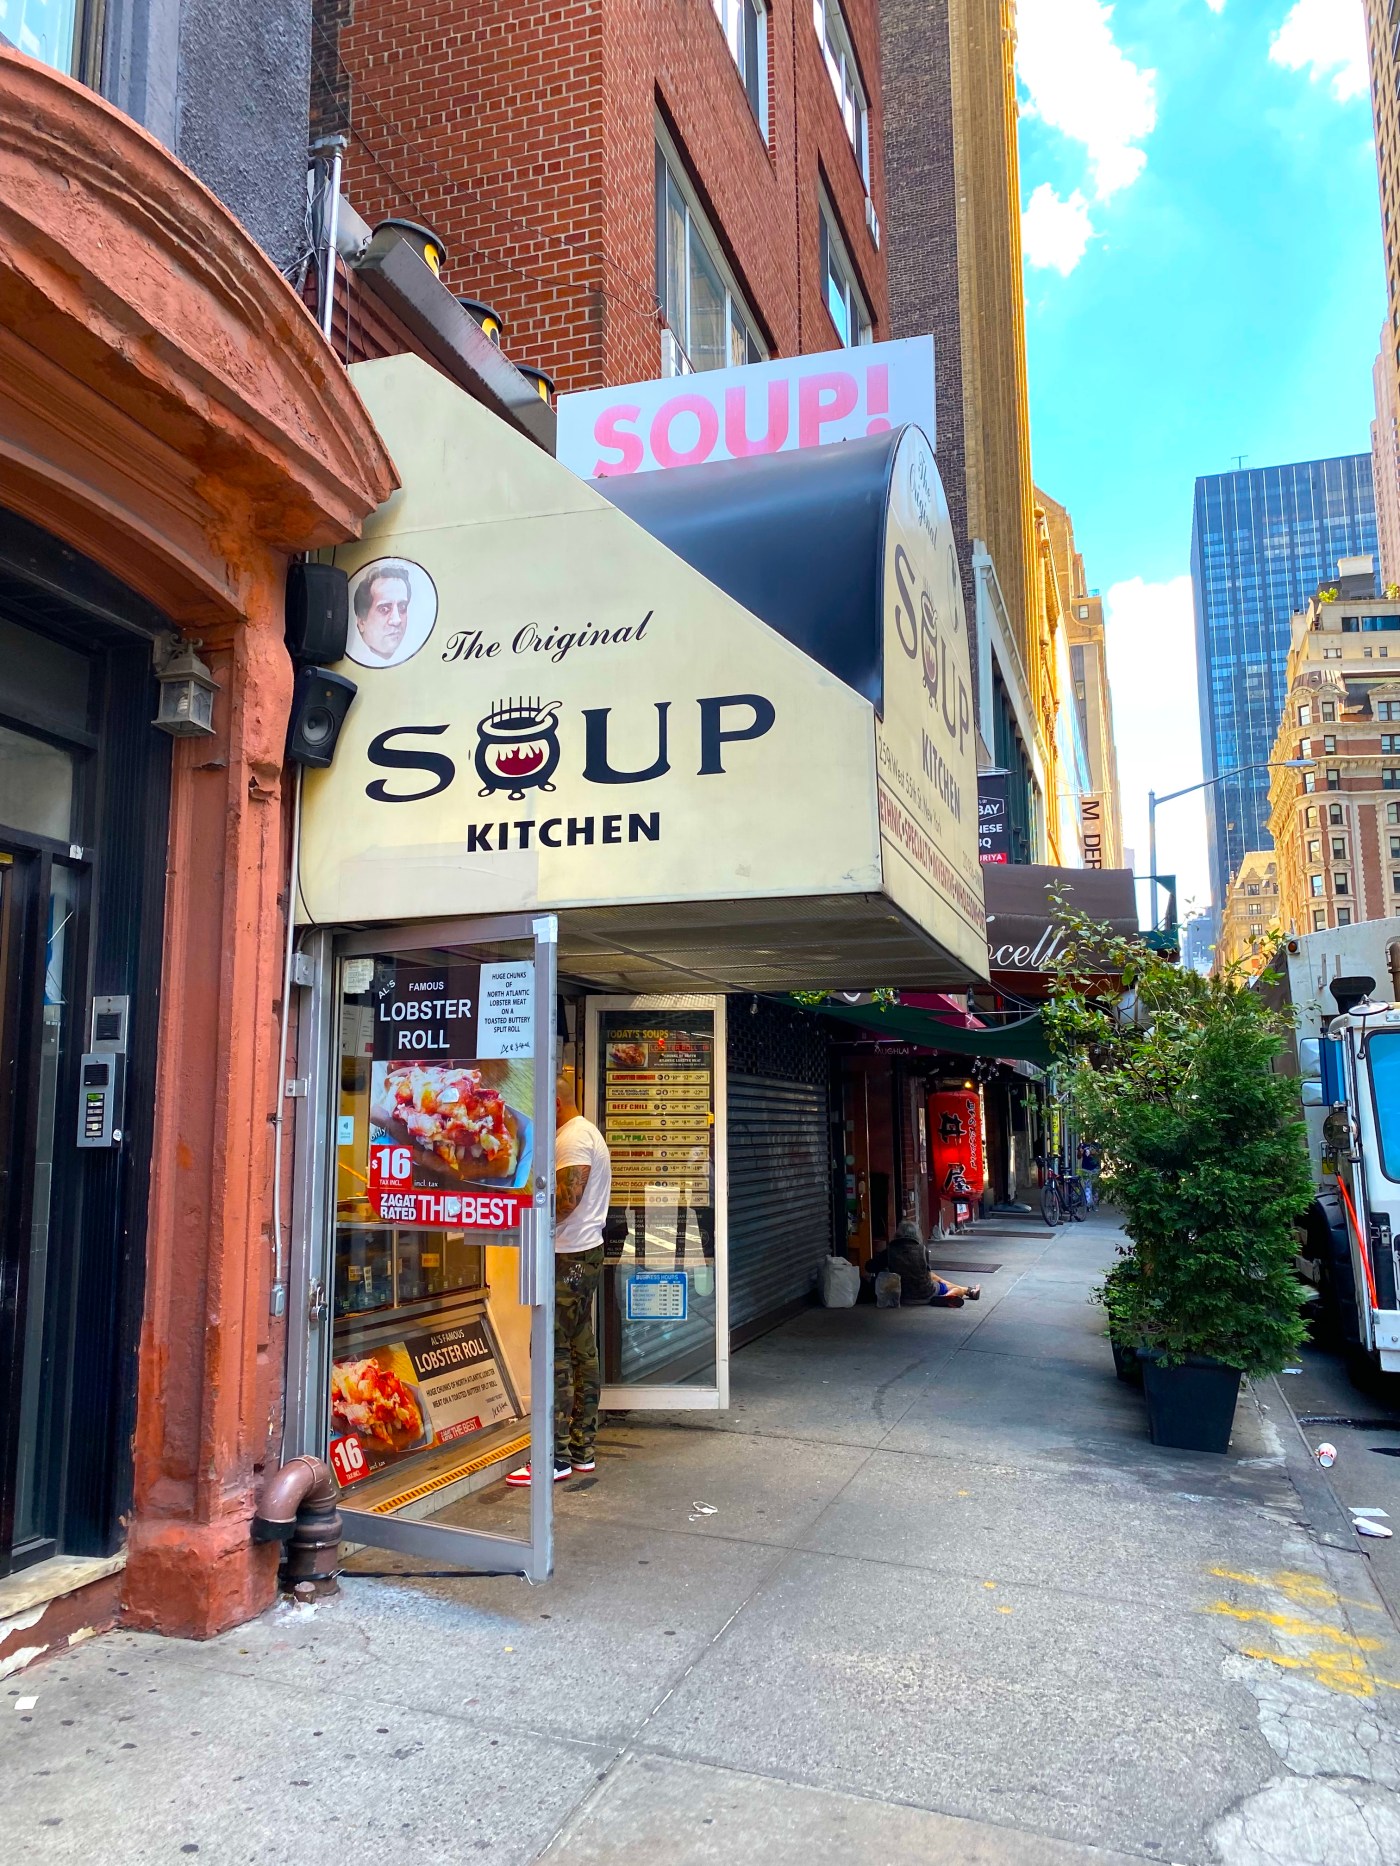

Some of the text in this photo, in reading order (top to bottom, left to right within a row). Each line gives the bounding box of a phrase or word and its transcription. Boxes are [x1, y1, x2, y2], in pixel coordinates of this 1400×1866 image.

[593, 363, 893, 479] SOUP!
[919, 451, 932, 502] The
[910, 463, 937, 551] Original
[442, 611, 655, 665] The Original
[365, 694, 776, 803] SOUP
[922, 727, 961, 825] KITCHEN
[879, 787, 903, 842] ETHNIC
[467, 811, 661, 852] KITCHEN
[408, 981, 445, 992] FAMOUS
[492, 971, 527, 980] HUGE CHUNKS
[378, 979, 396, 1000] AL'S
[487, 989, 530, 998] NORTH ATLANTIC
[379, 999, 472, 1022] LOBSTER
[489, 998, 526, 1007] LOBSTER MEAT
[508, 1016, 531, 1024] BUTTERY
[398, 1030, 451, 1050] ROLL
[606, 1029, 640, 1039] TODAY'S
[642, 1029, 669, 1039] SOUPS
[371, 1148, 411, 1179] $16
[380, 1193, 416, 1207] ZAGAT
[418, 1194, 517, 1226] THE BEST
[380, 1206, 416, 1221] RATED
[430, 1329, 465, 1346] AL'S FAMOUS
[414, 1337, 489, 1373] LOBSTER ROLL
[451, 1424, 465, 1438] THE
[463, 1418, 478, 1433] BEST
